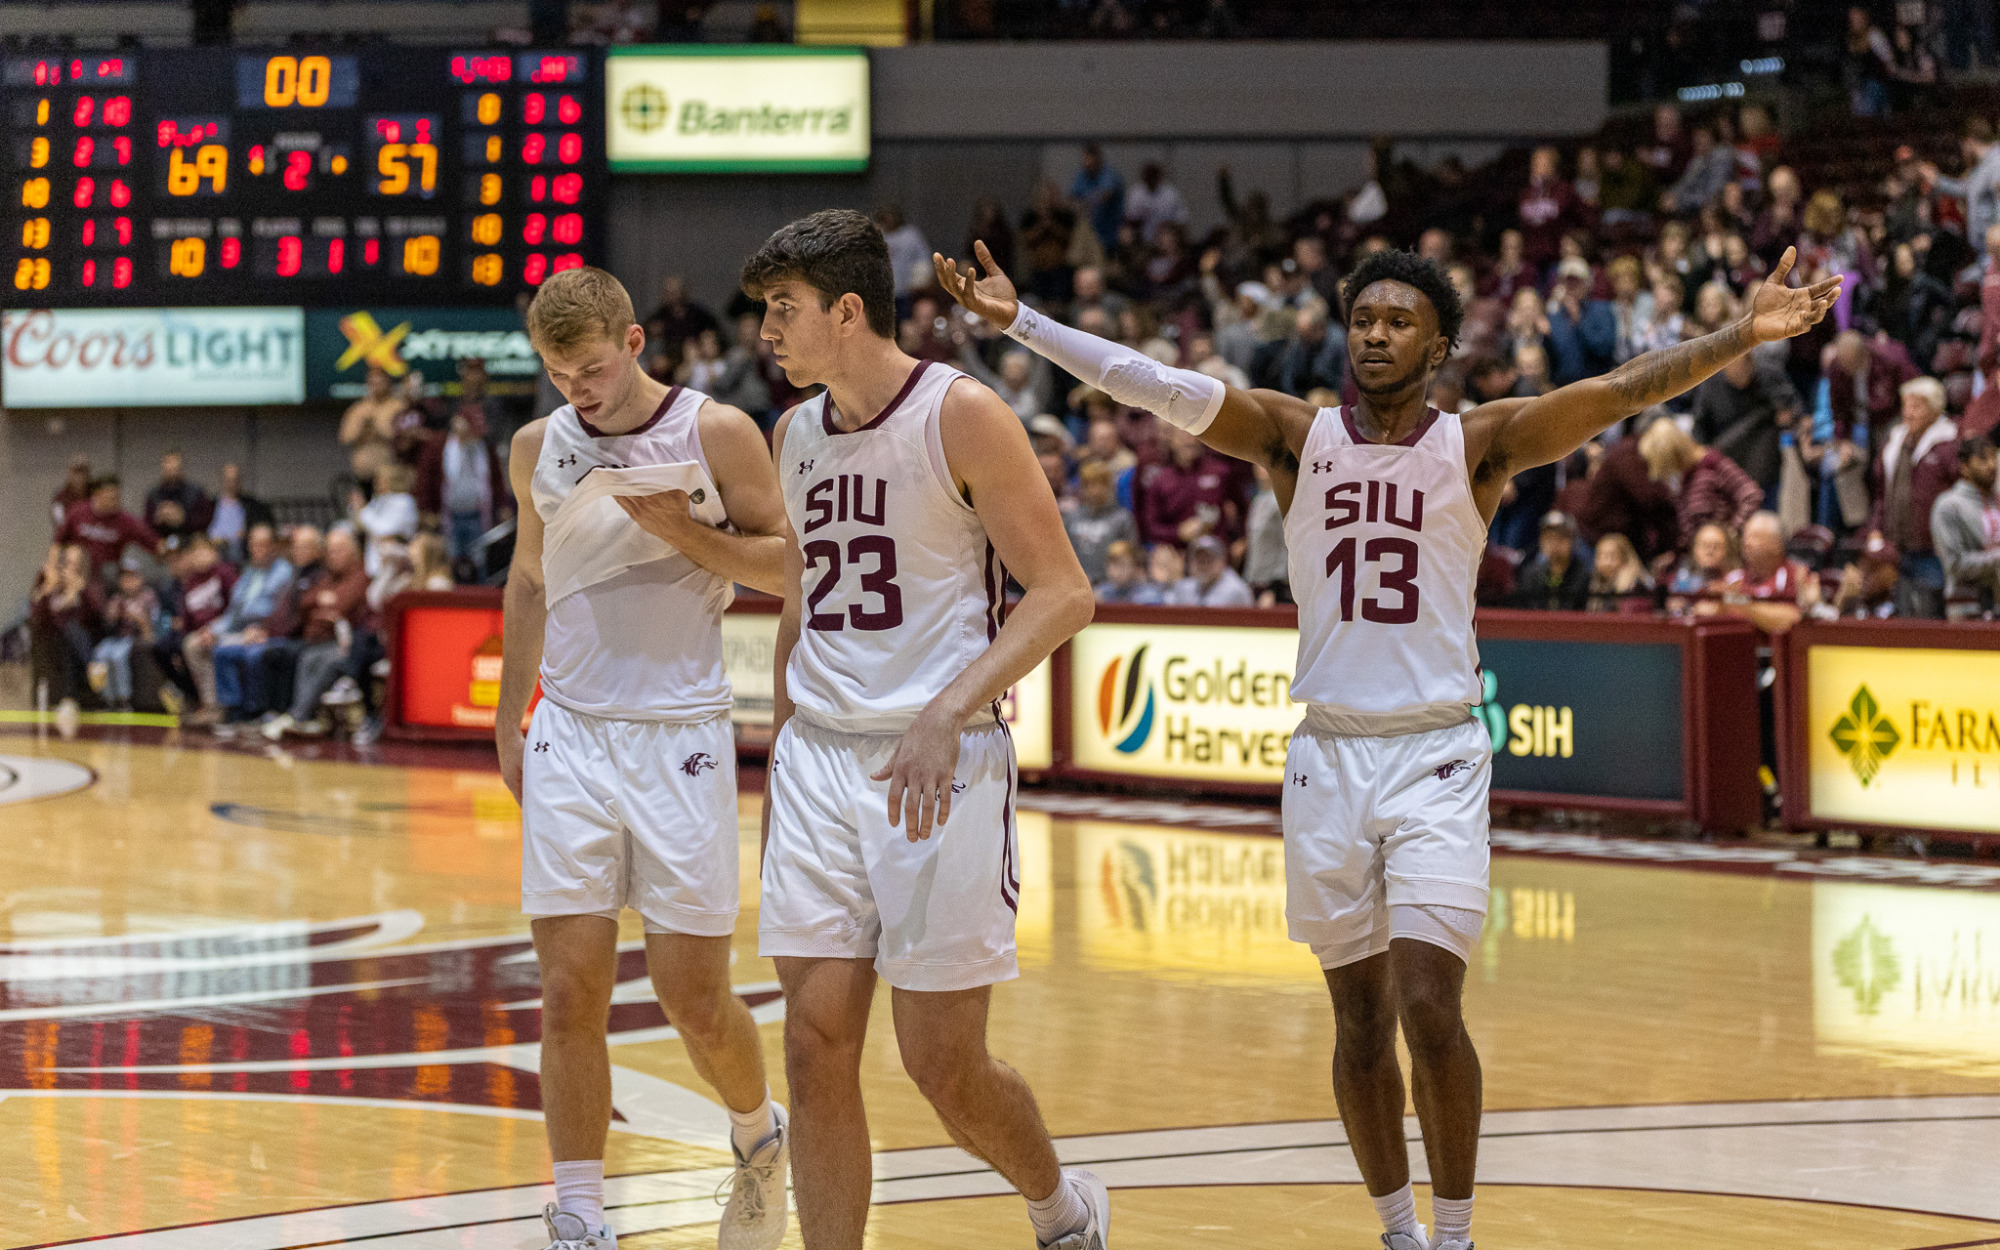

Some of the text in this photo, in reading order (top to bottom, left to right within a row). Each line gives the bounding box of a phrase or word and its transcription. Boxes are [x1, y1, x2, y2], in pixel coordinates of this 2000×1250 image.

[265, 56, 331, 107] 00
[37, 99, 49, 125] 1
[74, 96, 94, 127] 2
[678, 99, 853, 136] Banterra
[31, 137, 49, 168] 3
[73, 137, 94, 167] 2
[168, 142, 437, 195] 69 2 57
[487, 137, 501, 161] 1
[522, 133, 545, 164] 2
[74, 177, 94, 208] 2
[531, 176, 546, 201] 1
[83, 220, 95, 245] 1
[523, 213, 546, 244] 2
[15, 258, 50, 289] 23
[83, 260, 95, 286] 1
[170, 237, 205, 277] 10
[277, 236, 302, 276] 3
[328, 239, 343, 273] 1
[365, 240, 378, 263] 1
[404, 236, 439, 275] 10
[524, 254, 546, 285] 2
[4, 309, 297, 369] Coors LIGHT
[804, 474, 888, 534] SIU
[1325, 480, 1425, 532] SIU
[803, 534, 903, 631] 23
[1326, 537, 1420, 625] 13
[1164, 656, 1292, 707] Golden
[1165, 716, 1292, 768] Harves
[1508, 703, 1574, 759] SIH
